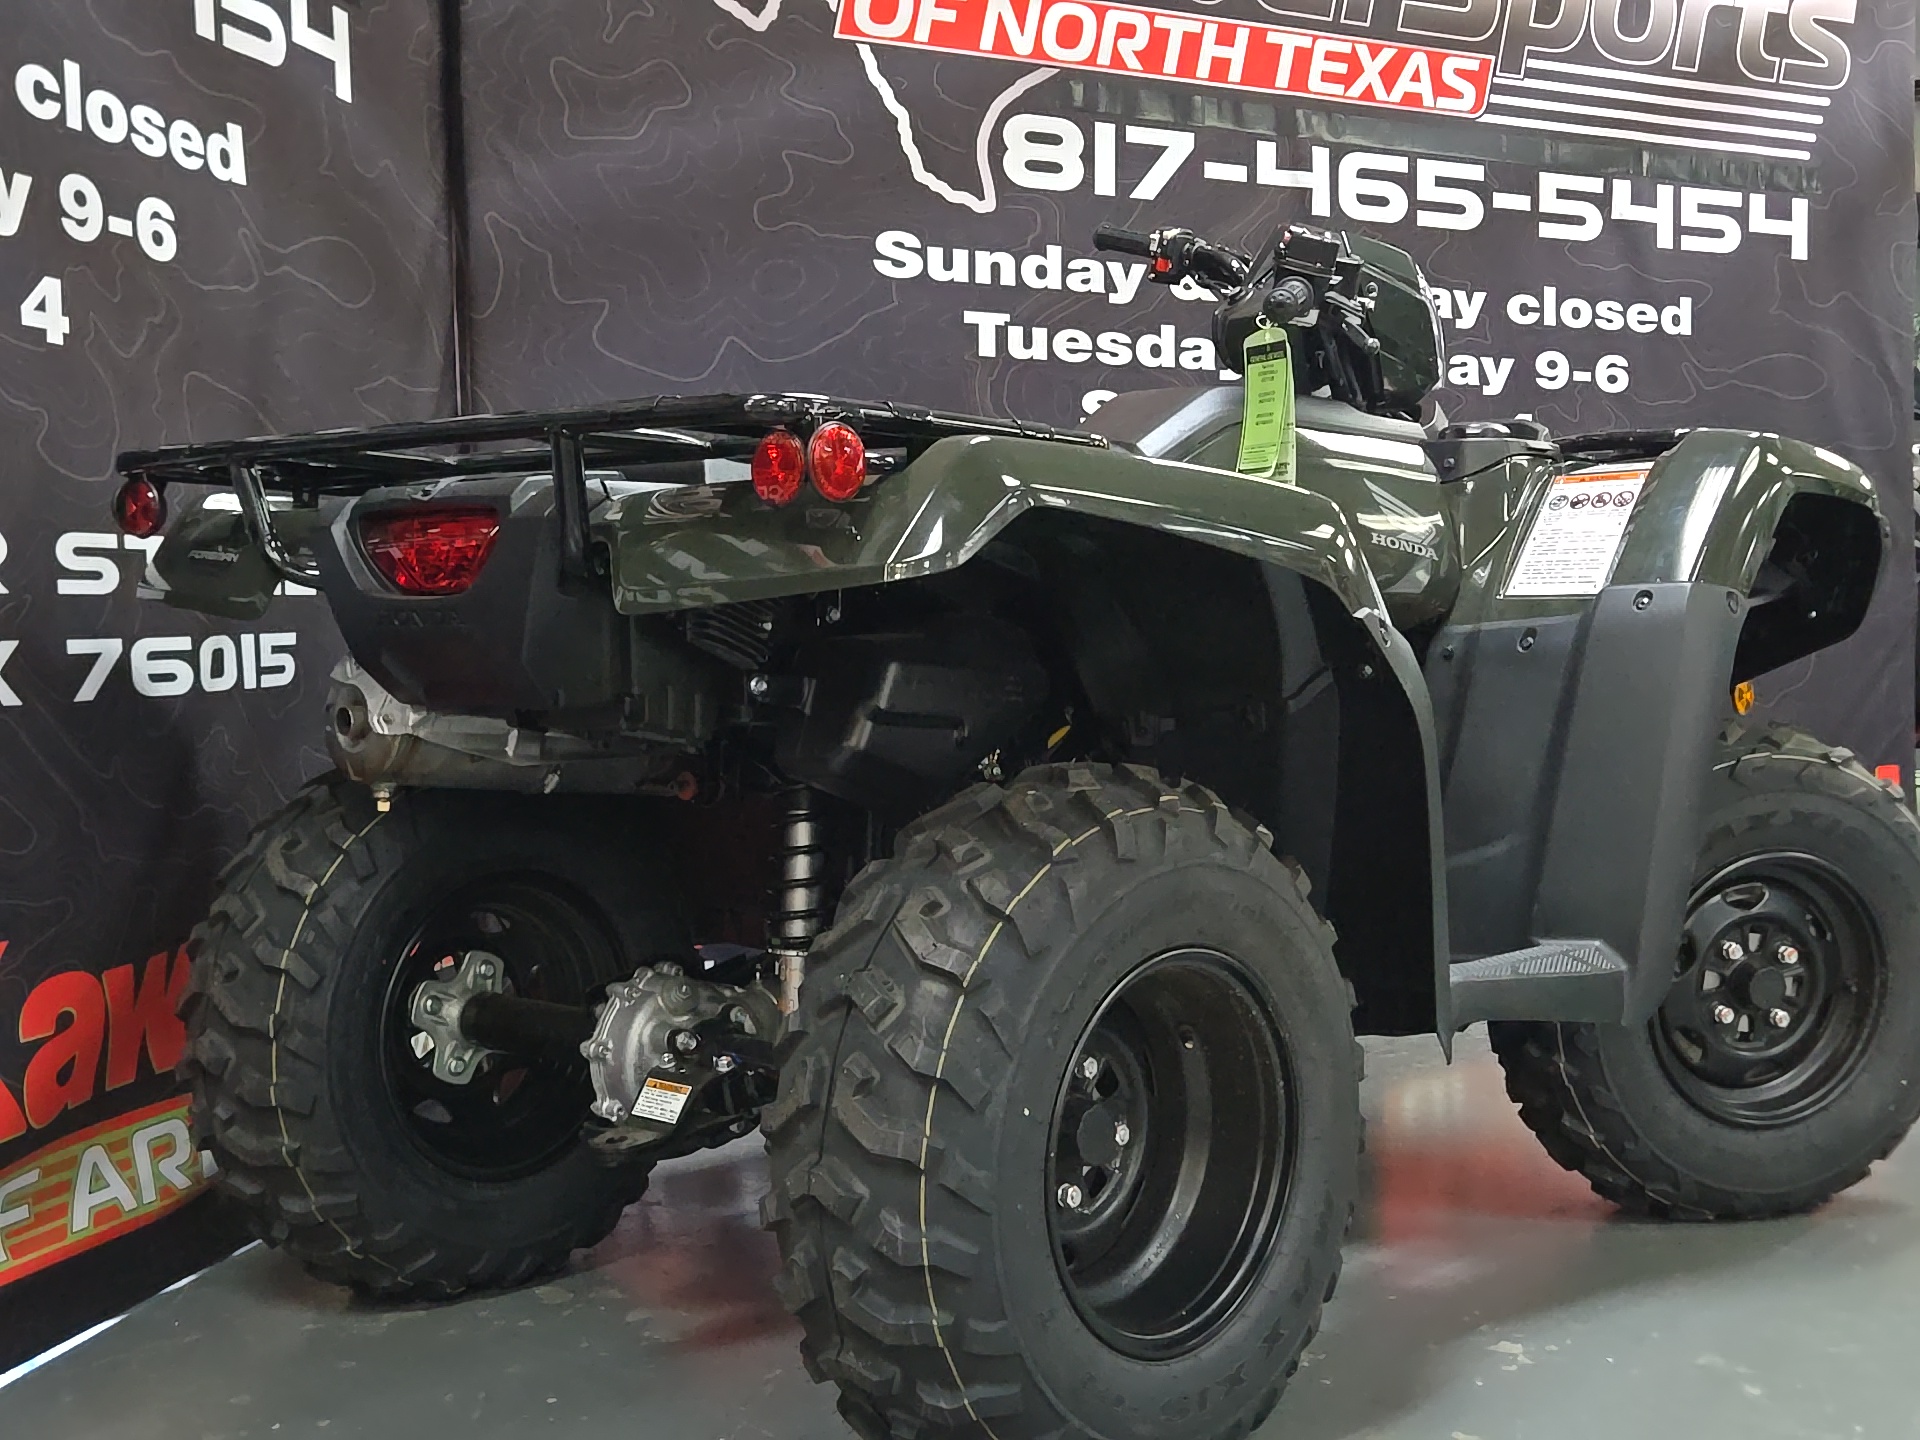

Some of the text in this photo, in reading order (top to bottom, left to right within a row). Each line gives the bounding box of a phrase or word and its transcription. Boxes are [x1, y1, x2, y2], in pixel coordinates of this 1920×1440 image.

[853, 0, 1481, 112] OF NORTH TEXAS
[15, 59, 247, 186] closed
[59, 174, 177, 262] 9-6
[1002, 113, 1809, 260] 817-465-5454
[20, 276, 70, 346] 4
[873, 230, 1148, 304] Sunday
[1507, 286, 1692, 335] closed
[964, 311, 1243, 381] Tuesda
[1535, 351, 1629, 393] 9-6
[1371, 532, 1439, 561] HONDA
[66, 632, 296, 703] 76015
[72, 1118, 218, 1234] AR
